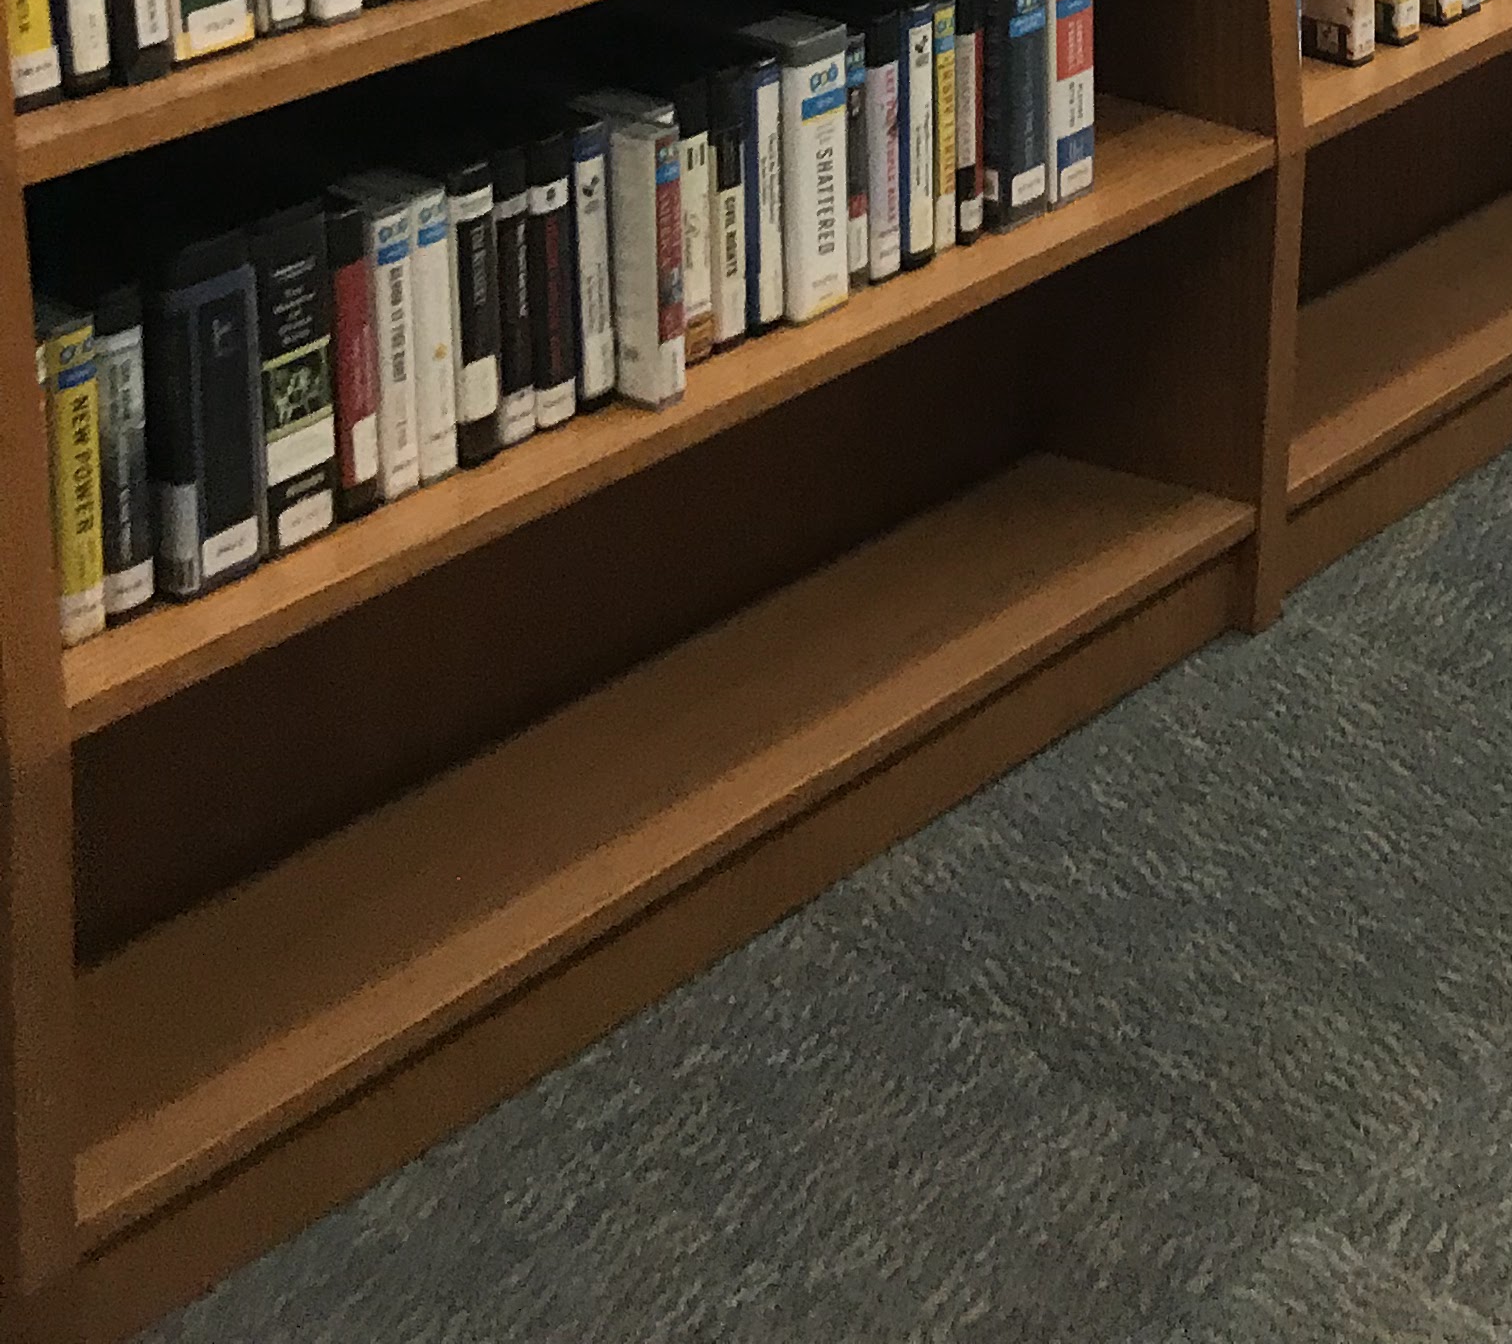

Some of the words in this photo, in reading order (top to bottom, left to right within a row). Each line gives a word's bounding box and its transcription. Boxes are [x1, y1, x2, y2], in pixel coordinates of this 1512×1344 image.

[816, 146, 835, 256] SHATTERED
[725, 231, 739, 277] RIGHTS
[72, 393, 93, 446] NEW
[73, 451, 95, 535] POWER
